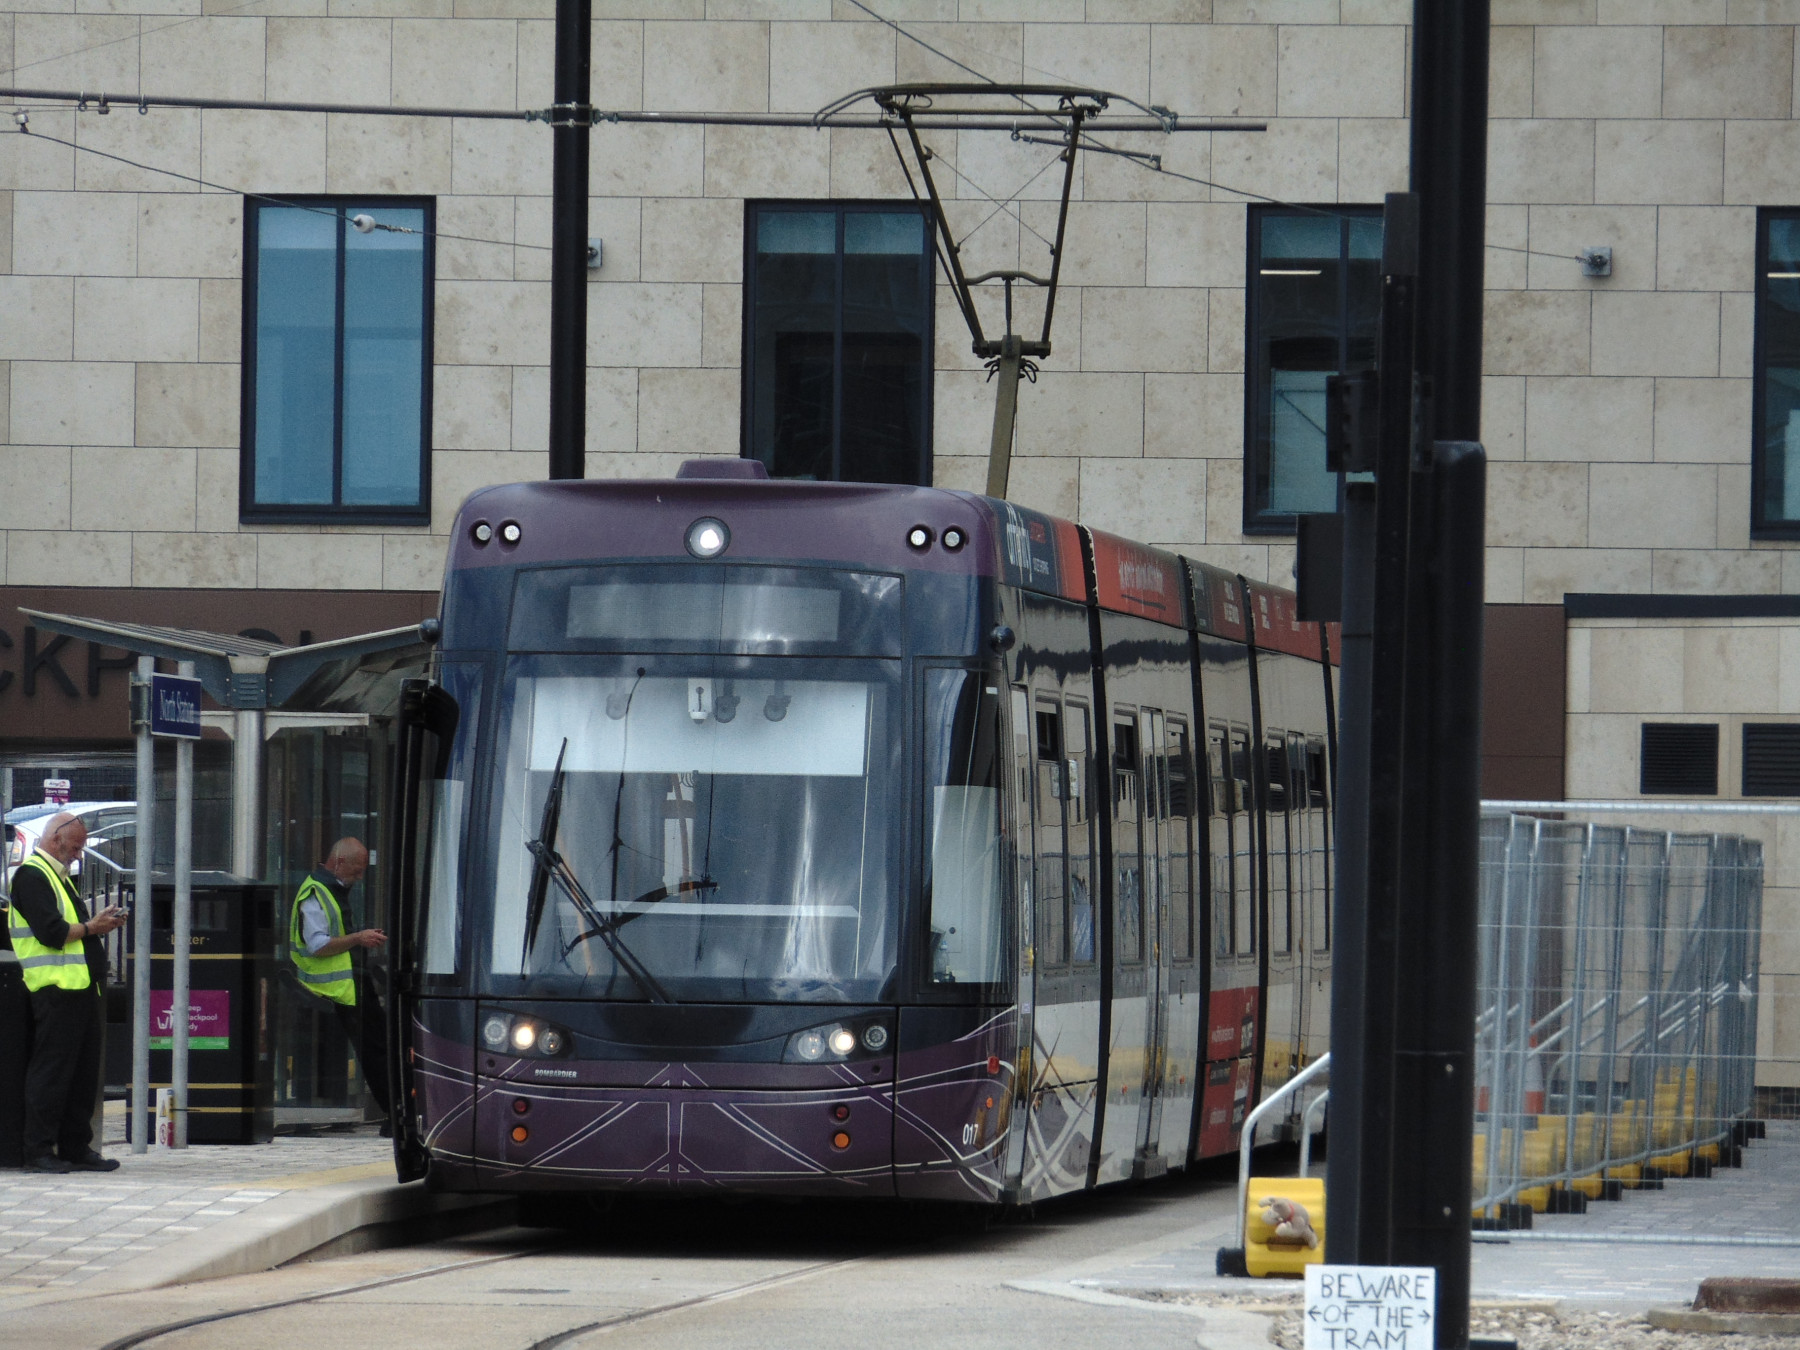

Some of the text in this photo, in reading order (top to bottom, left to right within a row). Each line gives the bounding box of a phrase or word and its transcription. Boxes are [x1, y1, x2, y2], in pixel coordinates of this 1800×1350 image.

[160, 689, 175, 722] North
[188, 1005, 202, 1013] eep
[188, 1013, 218, 1022] lackpool
[534, 1068, 578, 1079] BOMBARDIER
[962, 1123, 979, 1145] 017
[1321, 1272, 1430, 1300] BEWARE
[1323, 1304, 1414, 1329] OF THE
[1322, 1328, 1407, 1350] TRAM
